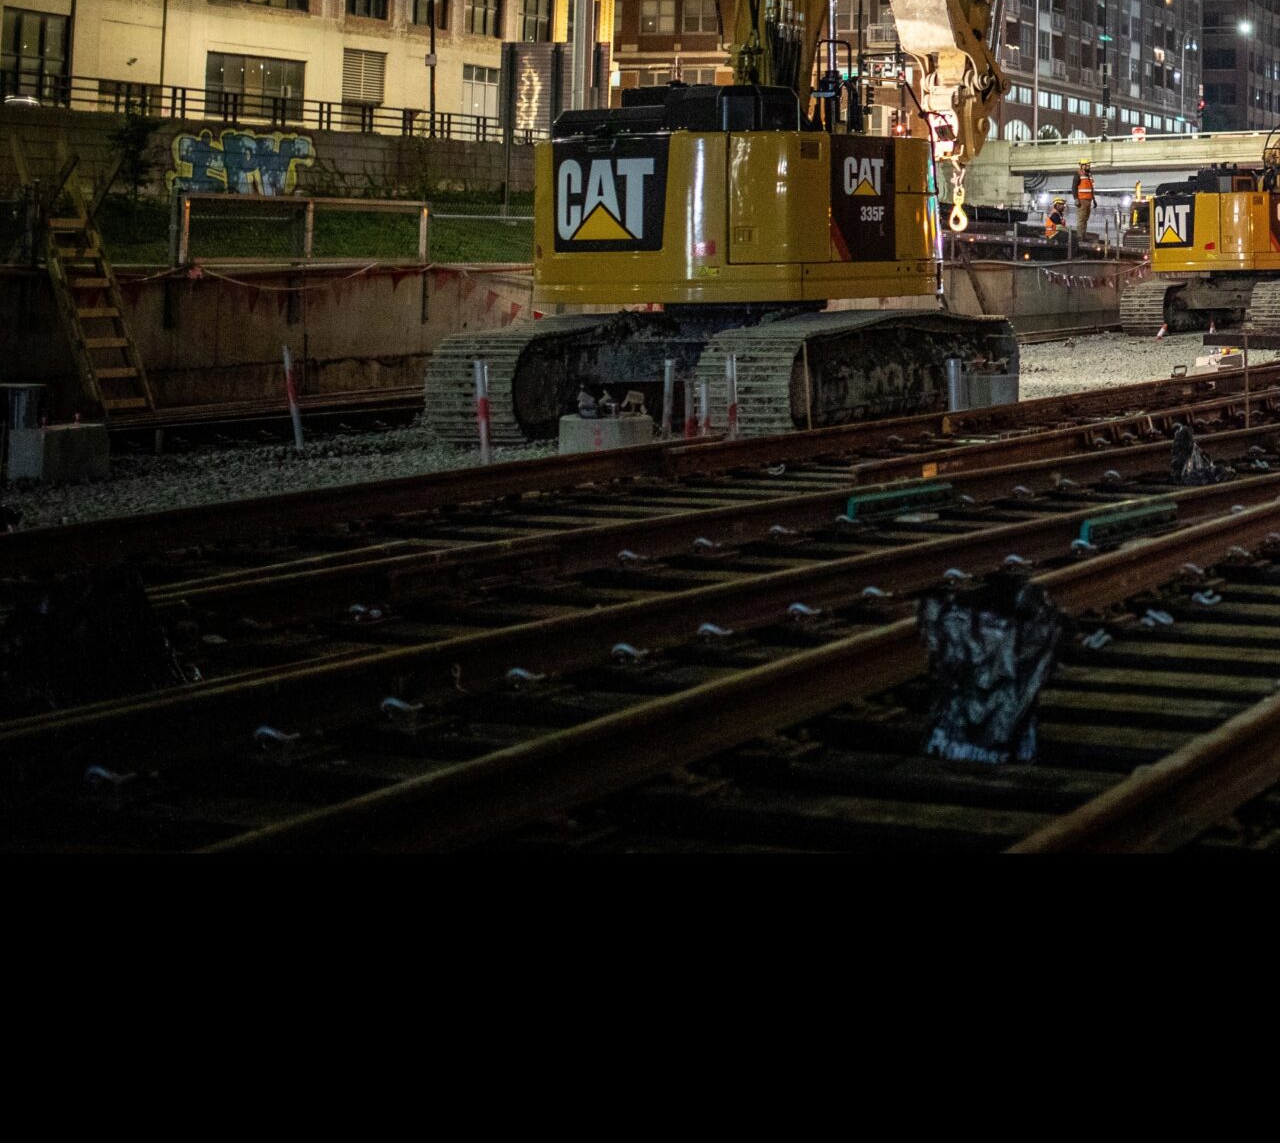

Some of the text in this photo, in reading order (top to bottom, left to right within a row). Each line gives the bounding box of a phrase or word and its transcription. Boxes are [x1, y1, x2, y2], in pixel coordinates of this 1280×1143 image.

[843, 156, 885, 196] CAT
[557, 158, 655, 241] CAT
[860, 206, 885, 221] 335F
[1154, 204, 1190, 244] CAT
